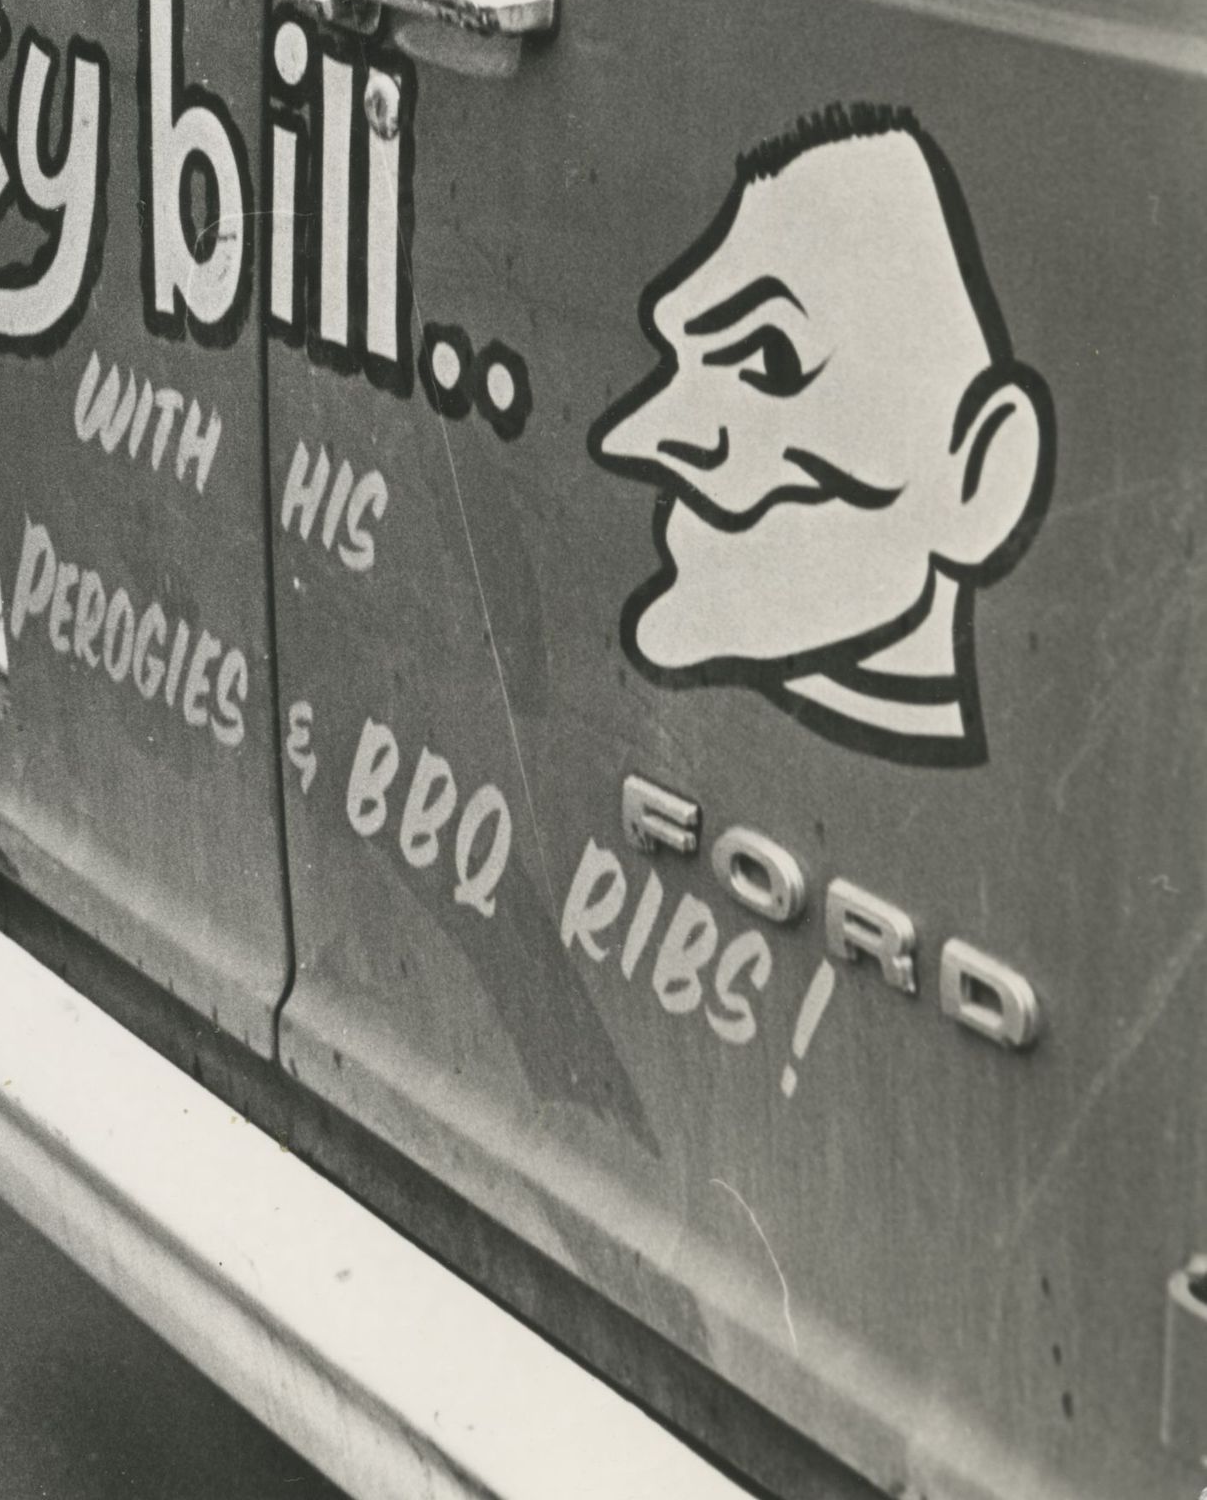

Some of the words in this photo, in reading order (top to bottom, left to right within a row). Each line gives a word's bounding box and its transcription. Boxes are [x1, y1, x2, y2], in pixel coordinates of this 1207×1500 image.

[74, 350, 222, 494] WITH
[281, 438, 389, 572] HIS
[11, 512, 248, 747] PEROGIES
[346, 717, 513, 918] BBQ
[561, 837, 835, 1098] RIBS!
[622, 773, 1037, 1050] FORD
